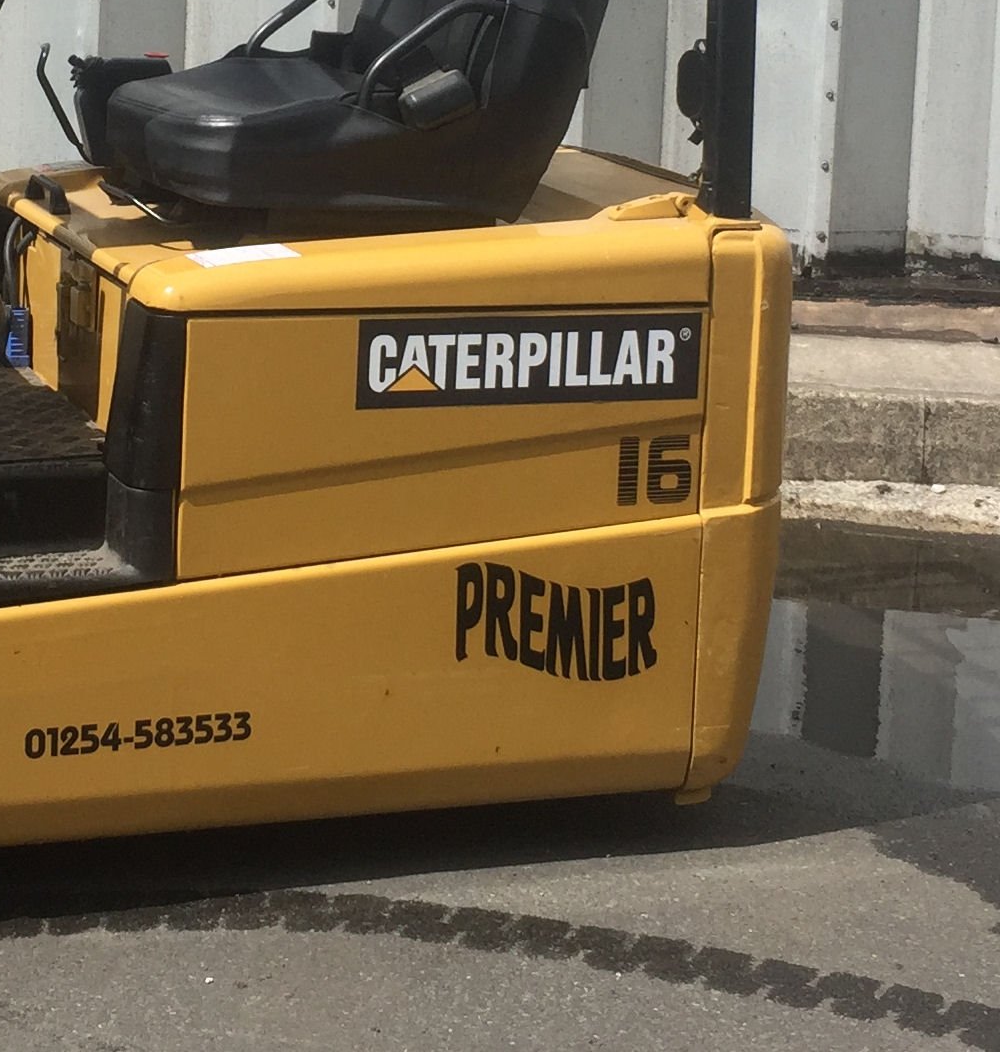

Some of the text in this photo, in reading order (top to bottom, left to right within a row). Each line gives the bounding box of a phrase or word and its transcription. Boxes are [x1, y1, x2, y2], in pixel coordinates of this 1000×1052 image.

[616, 434, 692, 507] 16
[455, 562, 658, 681] PREMIER
[24, 711, 252, 759] 01254-583533
